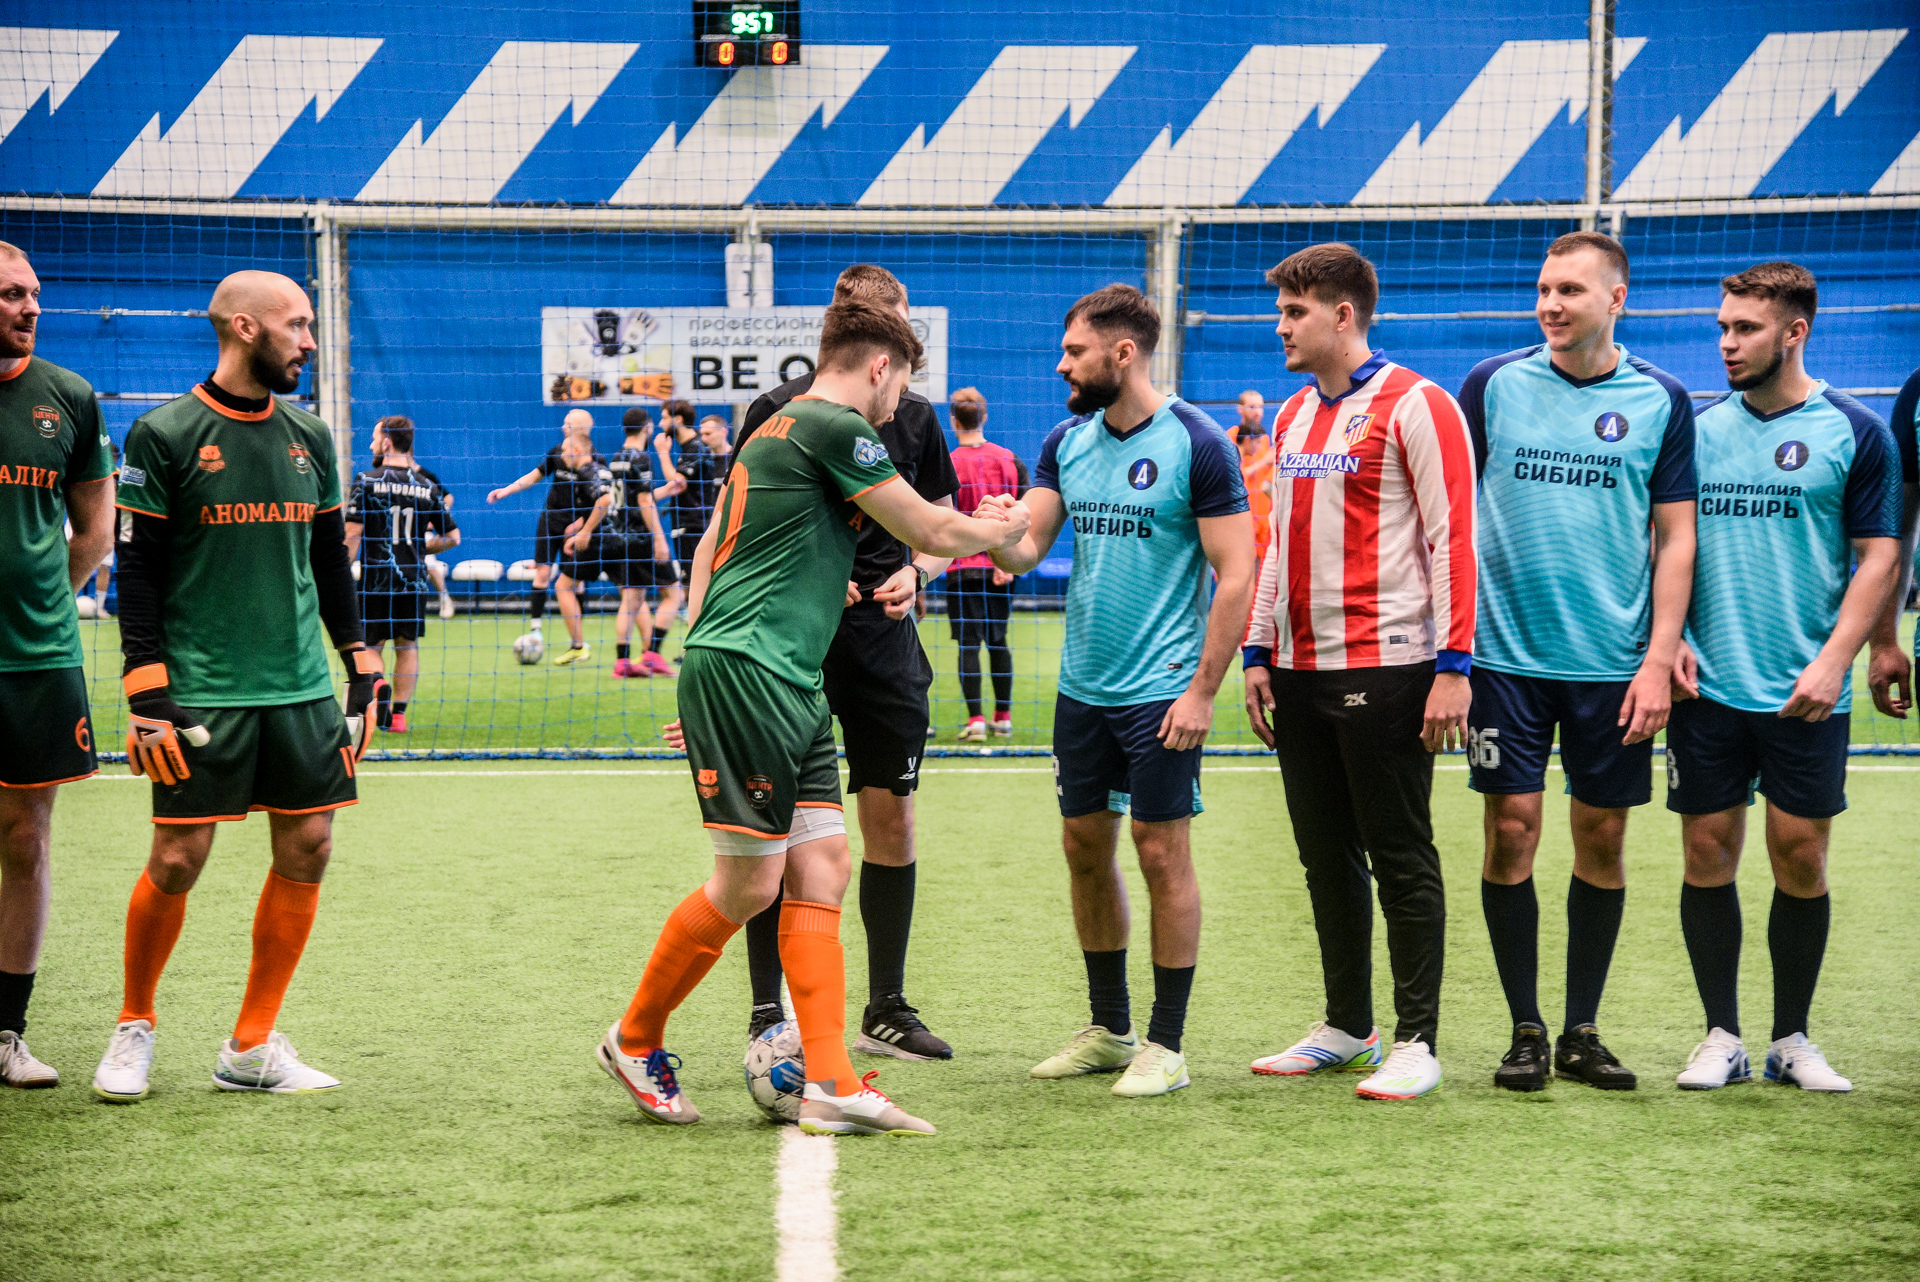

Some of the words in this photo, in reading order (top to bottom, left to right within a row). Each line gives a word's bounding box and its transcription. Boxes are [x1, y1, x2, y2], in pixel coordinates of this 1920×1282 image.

[718, 41, 735, 65] 0
[771, 41, 788, 64] 0
[689, 318, 824, 331] ПРОФЕССИОНА
[689, 335, 798, 348] ВРАТАРСКИЕ
[1280, 453, 1361, 475] AZERBAIJAN
[1515, 447, 1622, 467] АНОМАЛИЯ
[1300, 468, 1309, 477] OF
[1310, 468, 1328, 477] FIRE
[1514, 462, 1618, 489] СИБИРЬ
[1701, 482, 1802, 497] АНОМАЛИЯ
[200, 502, 316, 525] АНОМАЛИЯ
[1070, 501, 1156, 518] АНОМАЛИЯ
[1701, 498, 1799, 519] СИБИРЬ
[389, 505, 414, 545] 11
[1072, 515, 1153, 539] СИБИРЬ
[75, 716, 91, 752] 6
